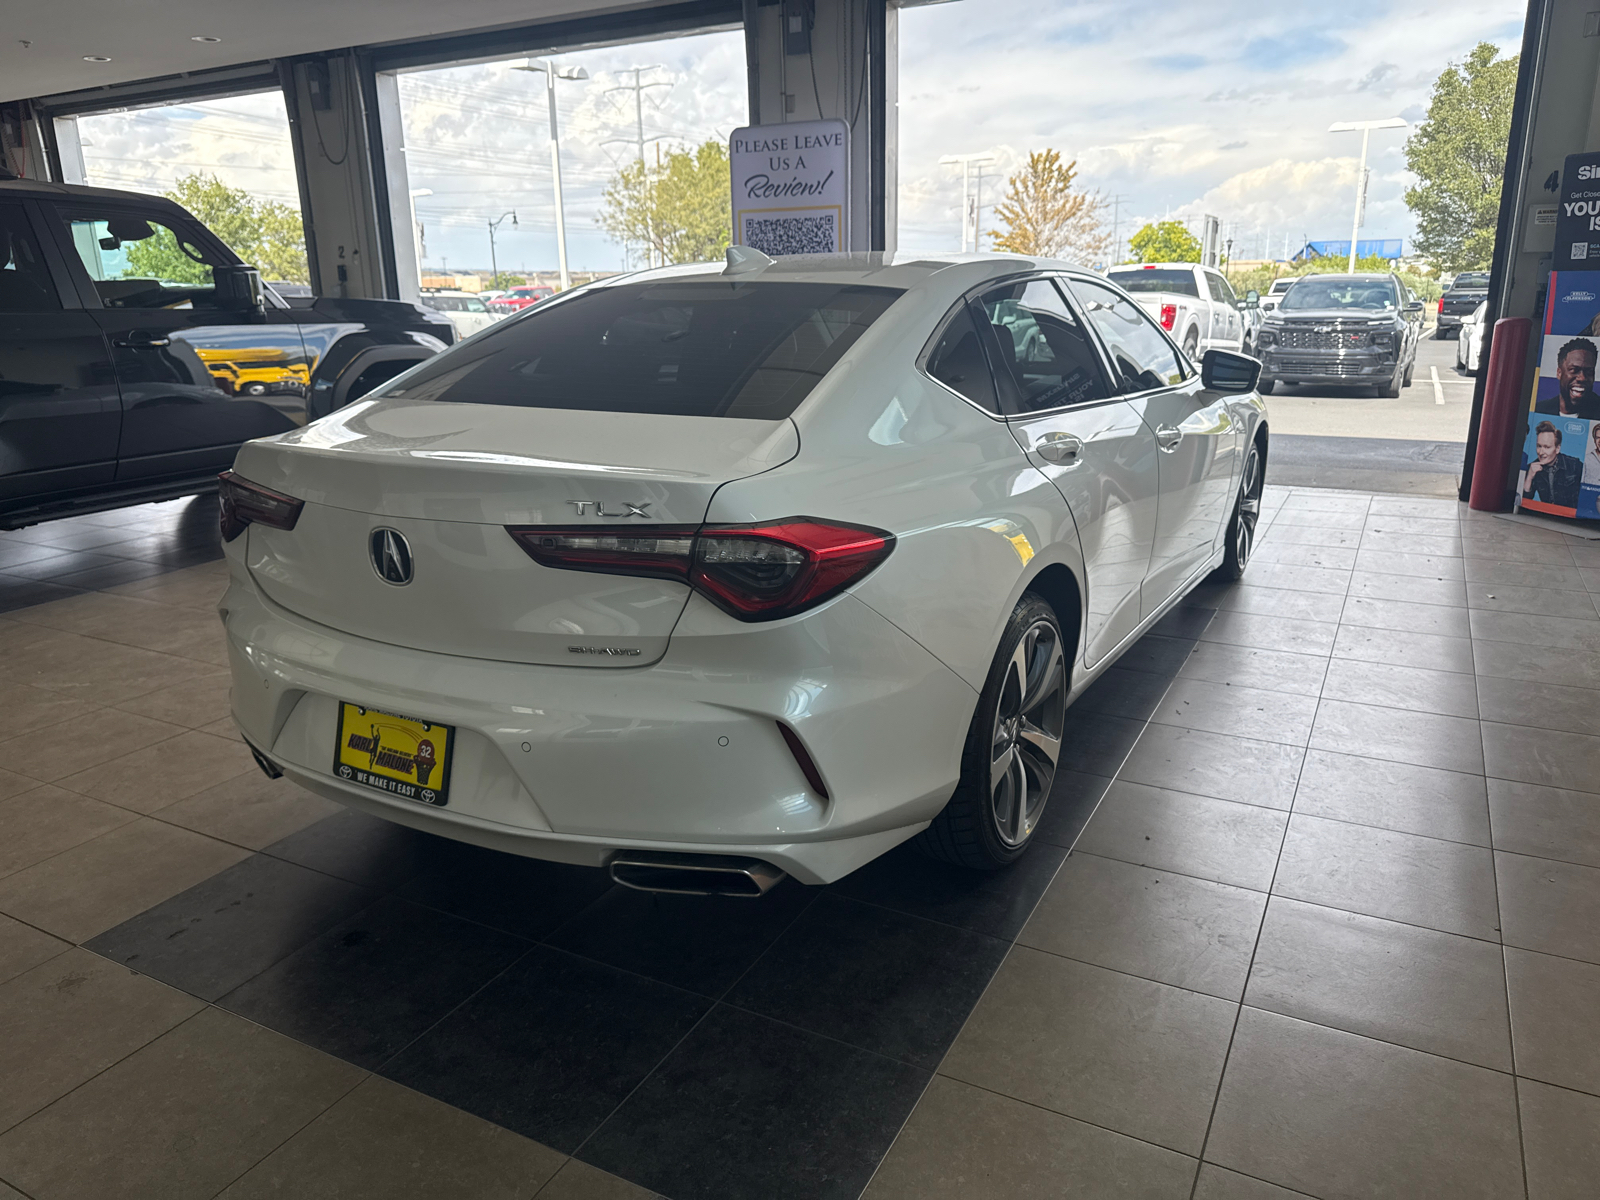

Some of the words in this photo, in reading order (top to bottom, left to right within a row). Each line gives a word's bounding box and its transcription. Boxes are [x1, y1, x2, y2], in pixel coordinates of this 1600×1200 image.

[735, 138, 788, 153] PLEASE
[794, 133, 842, 149] LEAVE
[795, 155, 806, 170] A
[744, 170, 833, 198] Review!
[1543, 170, 1559, 194] 4
[1563, 200, 1600, 217] YOU
[338, 245, 345, 259] 2
[566, 499, 652, 519] TLX
[347, 733, 374, 754] KARL
[420, 745, 432, 758] 32
[375, 750, 414, 775] MALONE
[357, 771, 368, 783] WE
[368, 774, 388, 788] MAKE
[389, 780, 397, 791] IT
[397, 783, 416, 797] EASY
